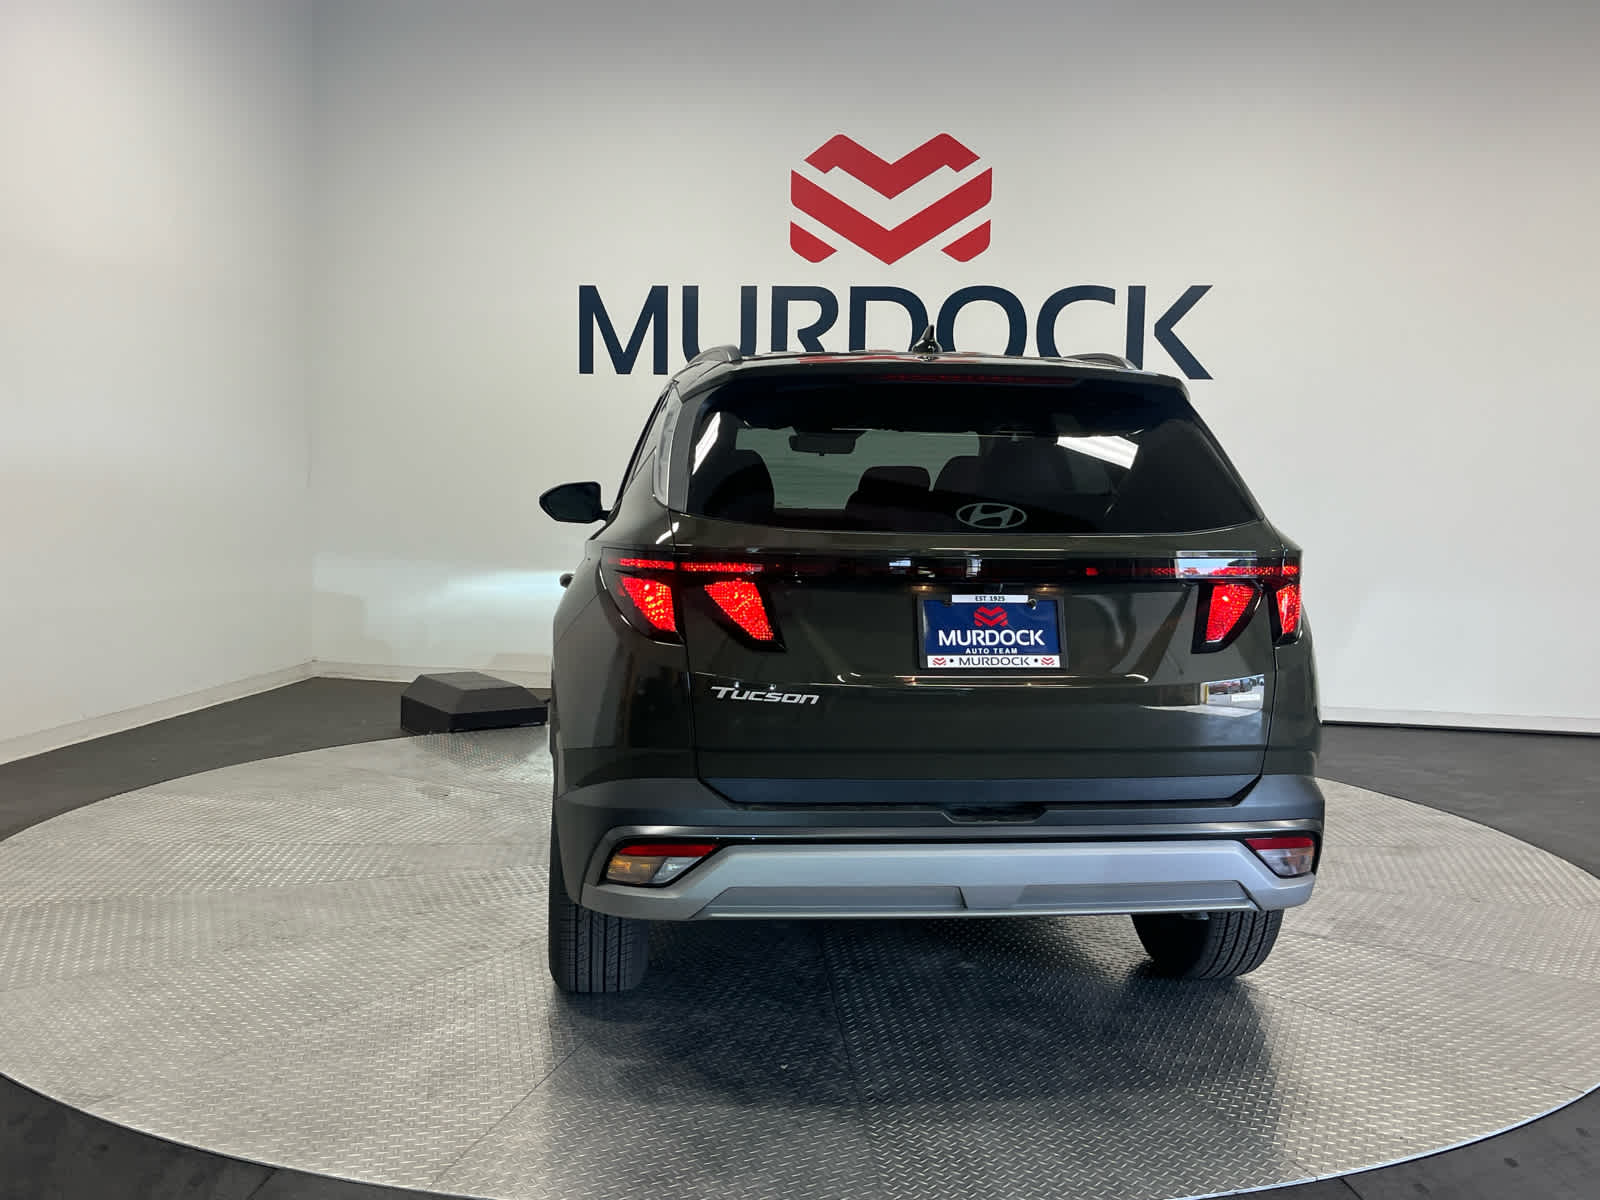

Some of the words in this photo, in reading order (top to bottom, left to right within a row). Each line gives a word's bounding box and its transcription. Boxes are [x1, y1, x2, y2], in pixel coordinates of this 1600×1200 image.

[578, 284, 1213, 380] MURDOCK
[938, 629, 1045, 646] MURDOCK
[958, 656, 1030, 666] MURDOCK
